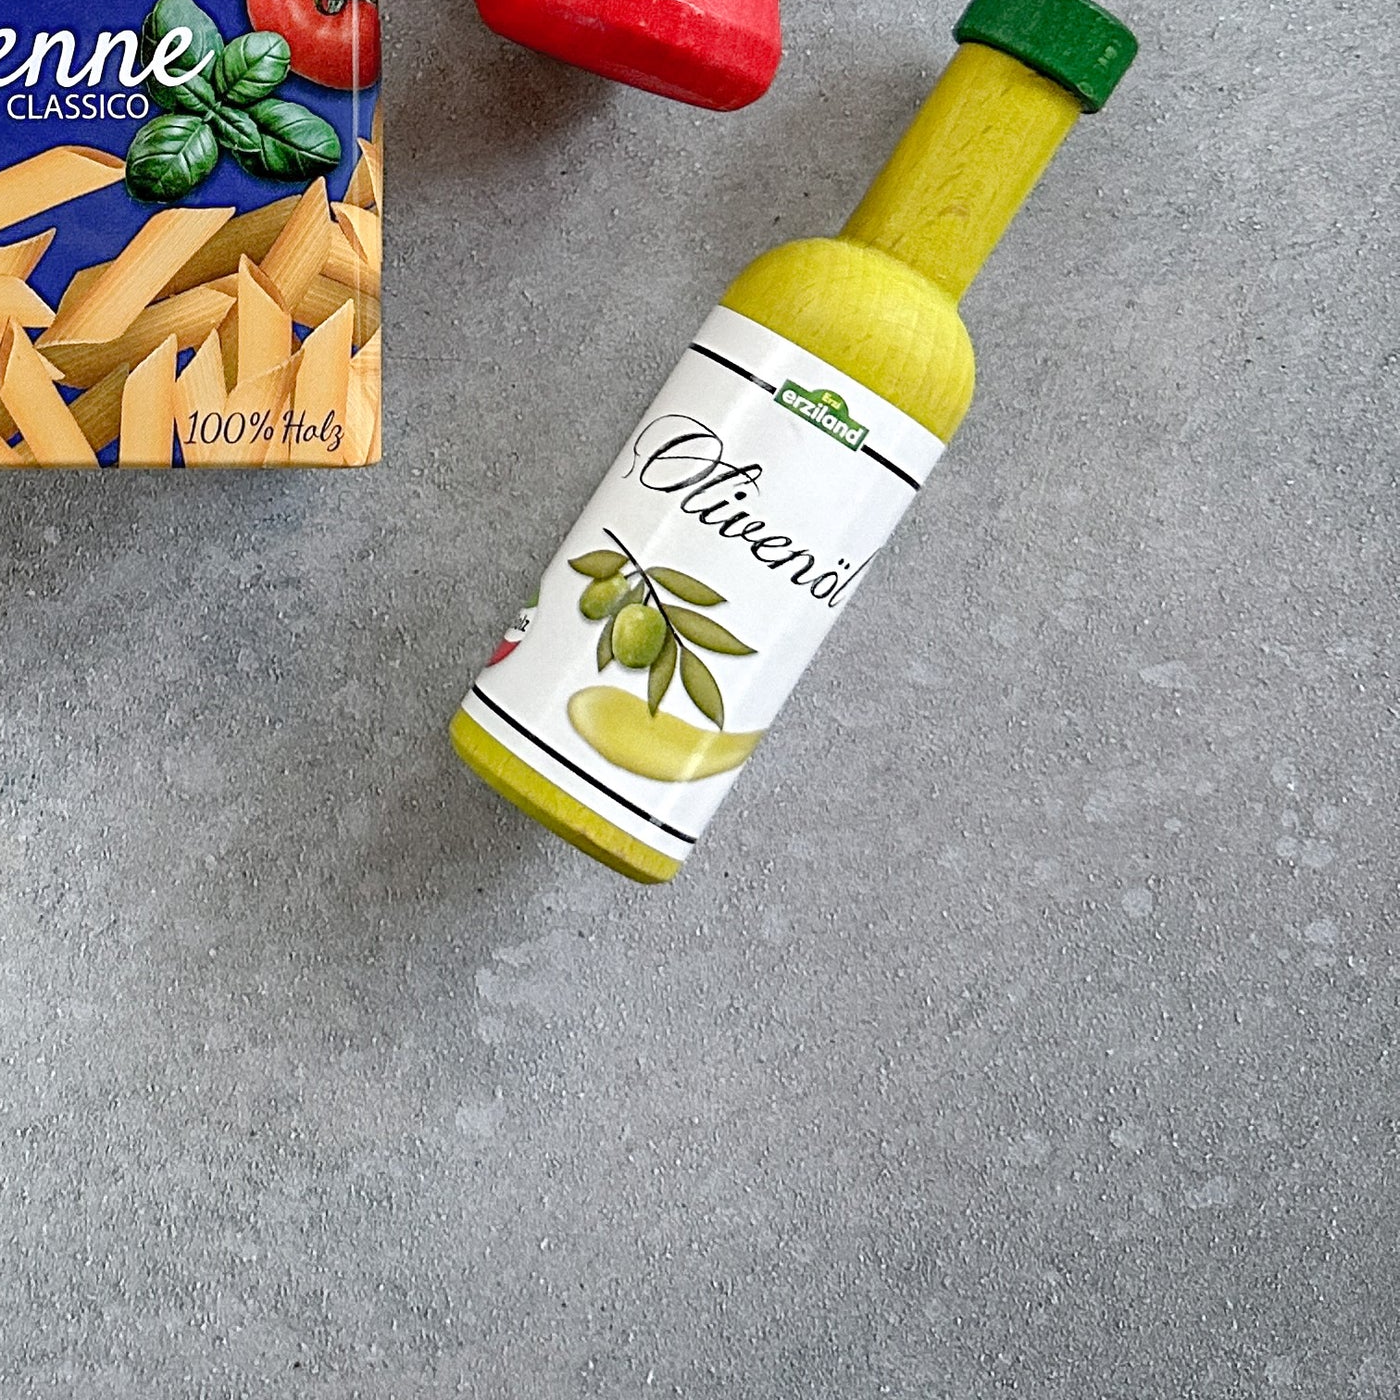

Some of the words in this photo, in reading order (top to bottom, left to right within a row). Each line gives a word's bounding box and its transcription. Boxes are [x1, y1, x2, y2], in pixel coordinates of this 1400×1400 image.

[6, 92, 150, 121] CLASSICO
[184, 409, 275, 445] 100%
[282, 409, 345, 452] Holz
[781, 389, 865, 446] erziland
[622, 413, 879, 608] Olivenöl
